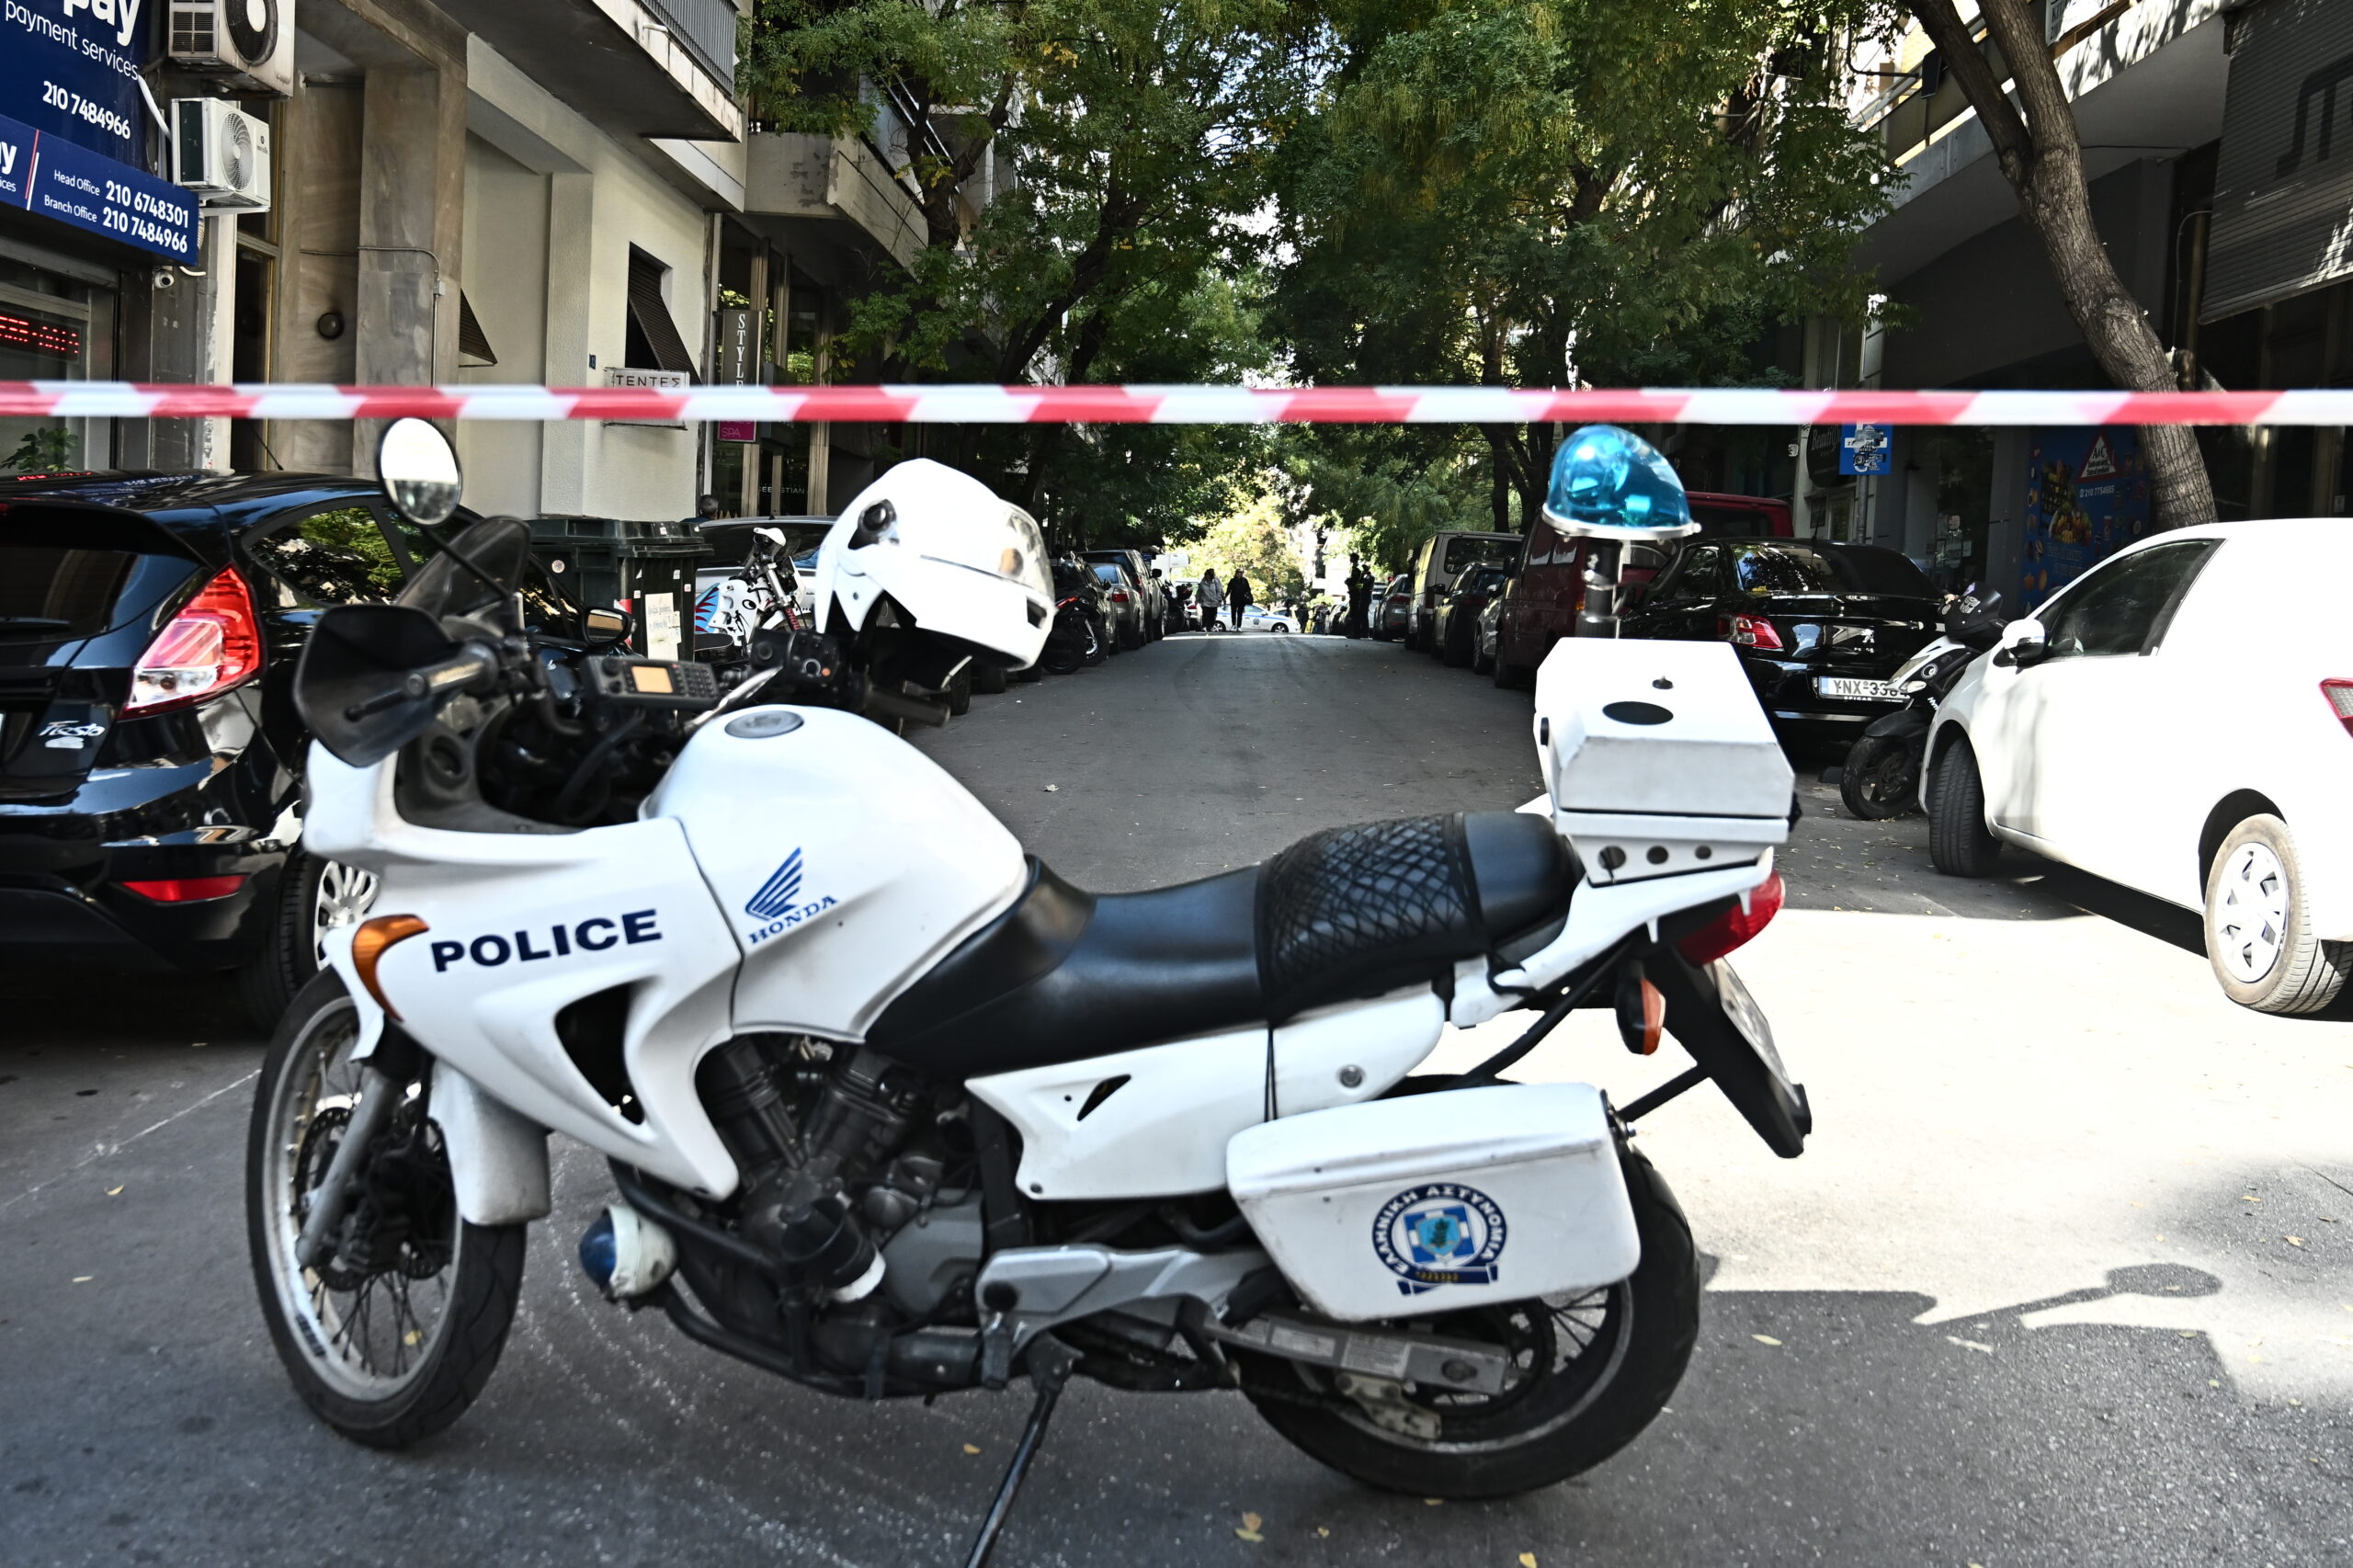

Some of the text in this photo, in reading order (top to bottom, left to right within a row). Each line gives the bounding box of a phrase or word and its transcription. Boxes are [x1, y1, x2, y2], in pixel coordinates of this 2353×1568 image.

[6, 0, 139, 80] payment services
[42, 81, 131, 139] 210 7484966
[44, 194, 188, 253] Branch Office 210 7484966
[54, 169, 188, 229] Head Office 210 6748301
[722, 427, 742, 437] SPA
[431, 909, 663, 972] POLICE
[748, 894, 839, 945] HONDA
[1375, 1185, 1504, 1274] ΕΛΛΗΝΙΚΗ ΑΣΤΥΝΟΜΙΑ
